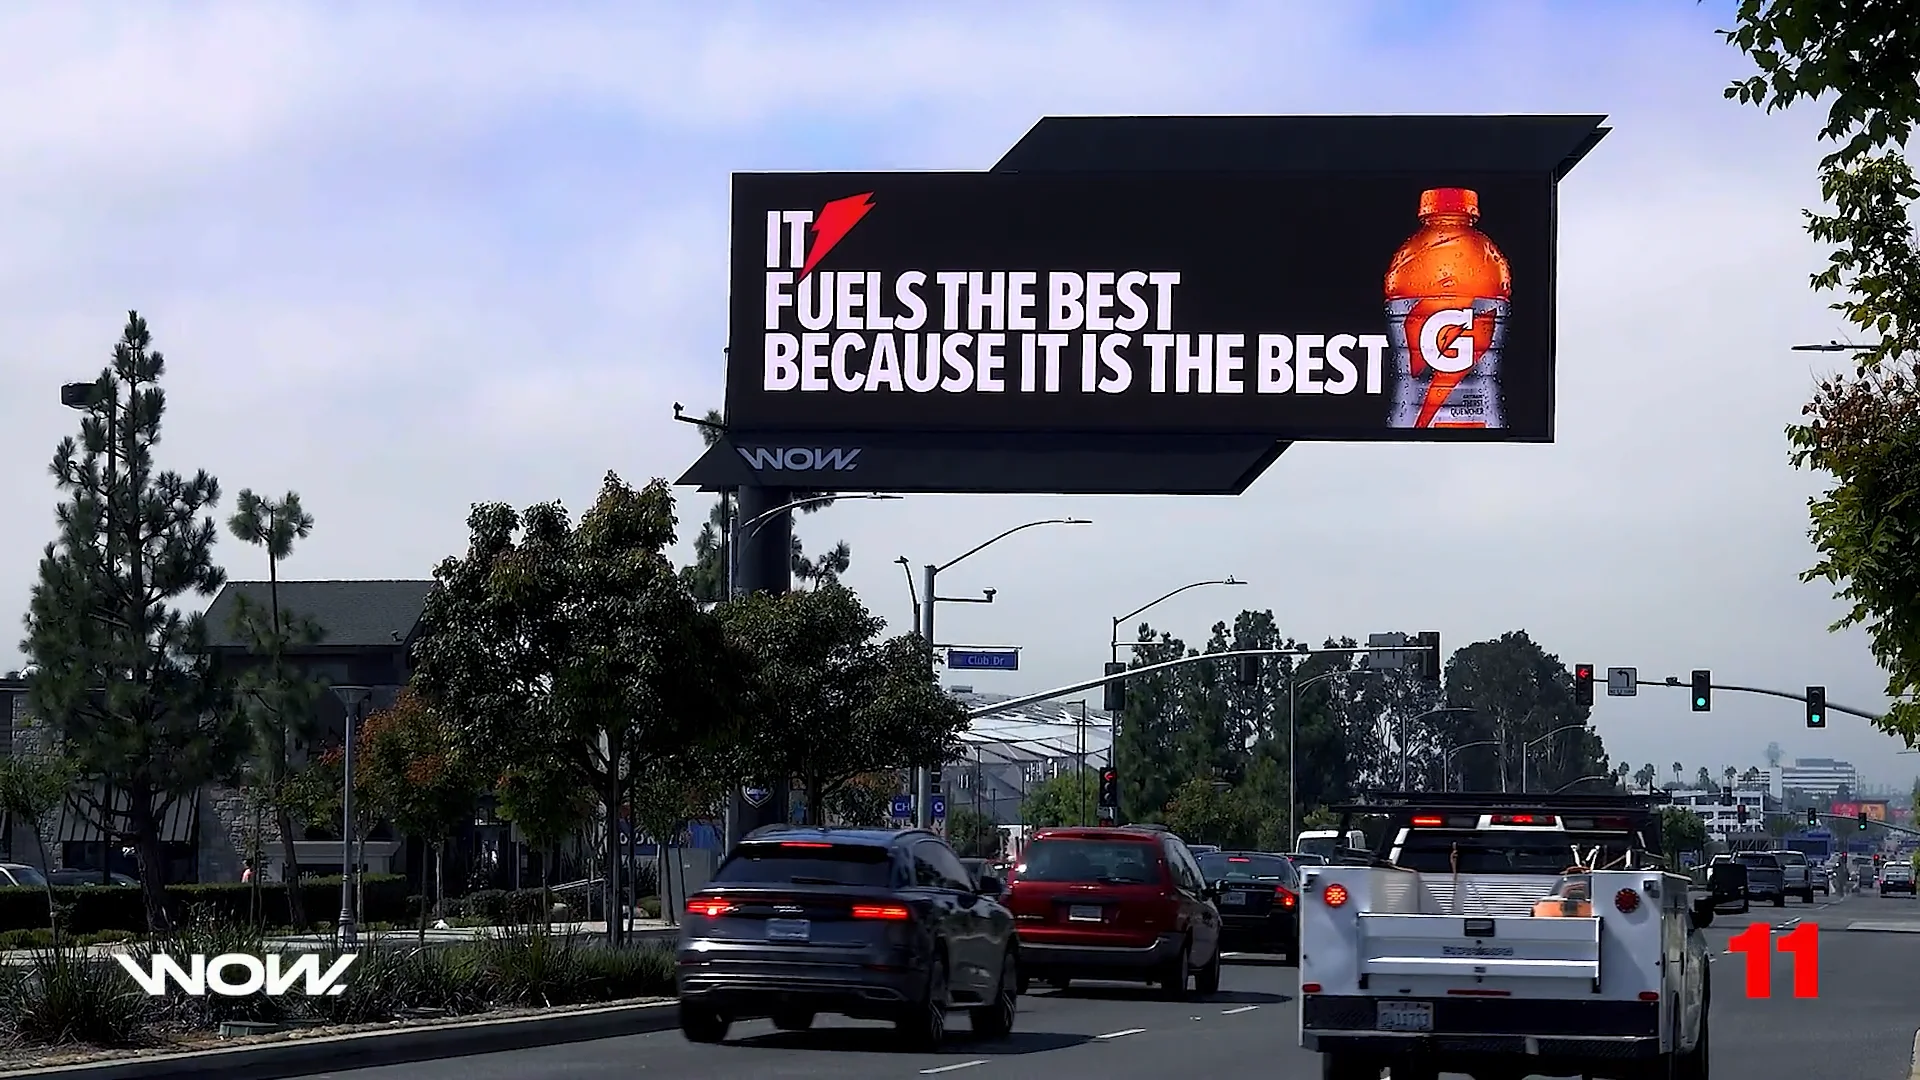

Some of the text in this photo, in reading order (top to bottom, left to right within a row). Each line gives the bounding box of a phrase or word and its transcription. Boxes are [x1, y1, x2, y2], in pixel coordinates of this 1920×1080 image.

[766, 210, 814, 268] IT
[765, 271, 1181, 331] FUELS THE BEST
[764, 333, 1390, 394] BECAUSE IT IS THE BEST
[1419, 308, 1474, 373] G
[967, 655, 1005, 666] Club Dr
